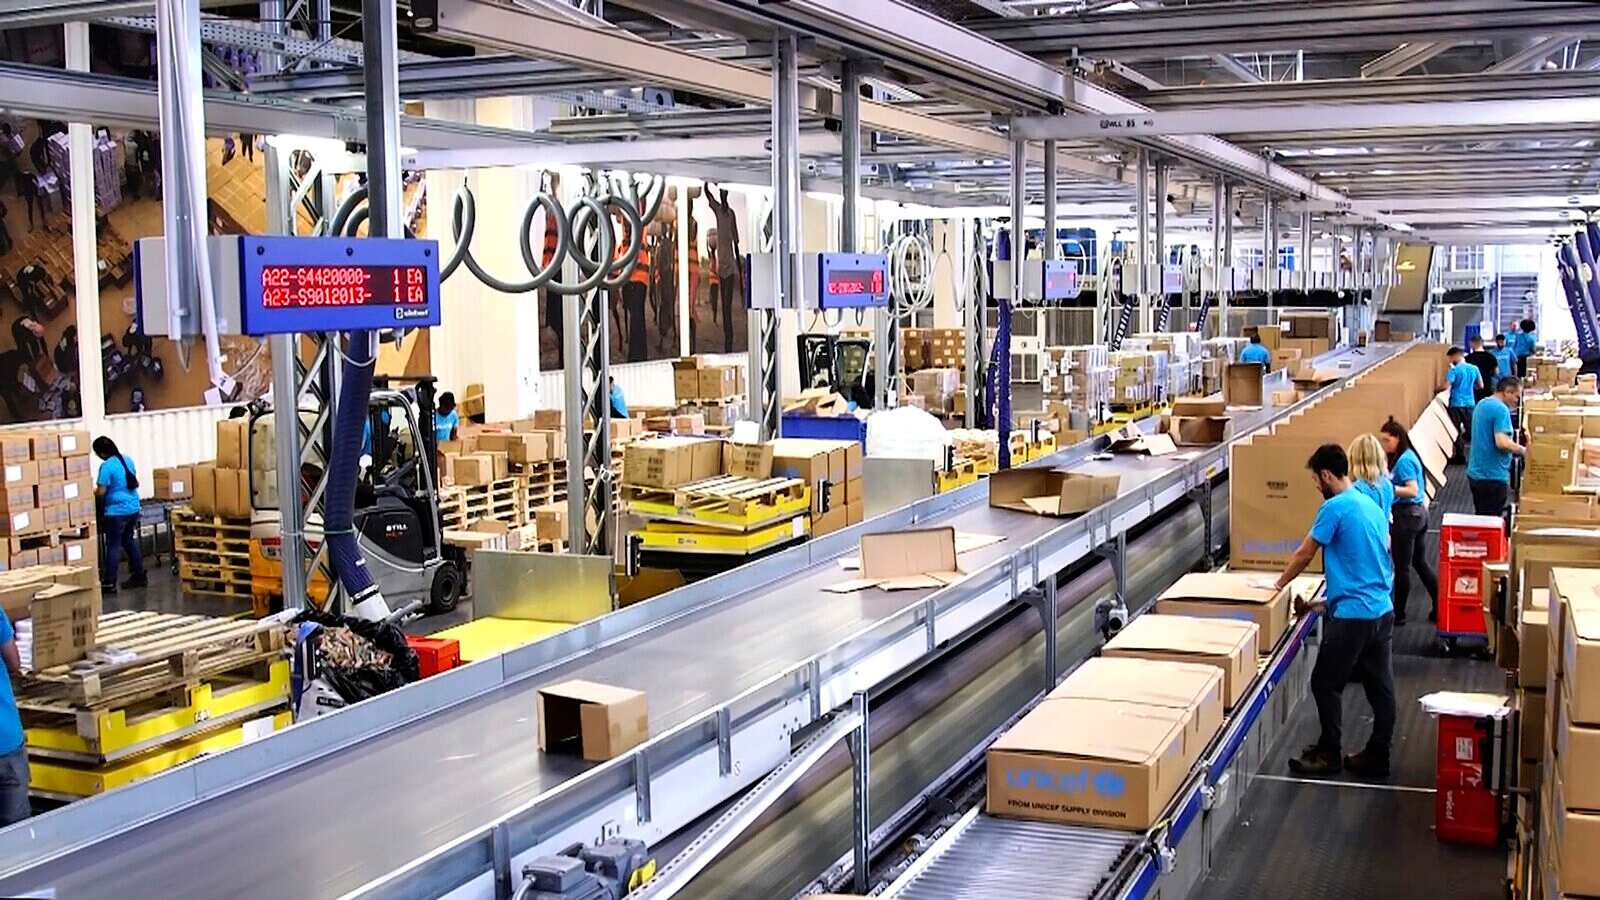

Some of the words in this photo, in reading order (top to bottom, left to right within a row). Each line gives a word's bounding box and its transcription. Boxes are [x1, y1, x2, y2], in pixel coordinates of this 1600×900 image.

[261, 268, 371, 286] A22-S4420000-
[393, 268, 400, 285] 1
[407, 268, 423, 285] EA
[262, 287, 372, 306] A23-S9012013-
[394, 287, 401, 303] 1
[407, 287, 424, 303] EA
[1007, 800, 1030, 810] FROM
[1031, 801, 1060, 812] UNICEF
[1061, 804, 1091, 816] SUPPLY
[1092, 807, 1127, 820] DIVISION
